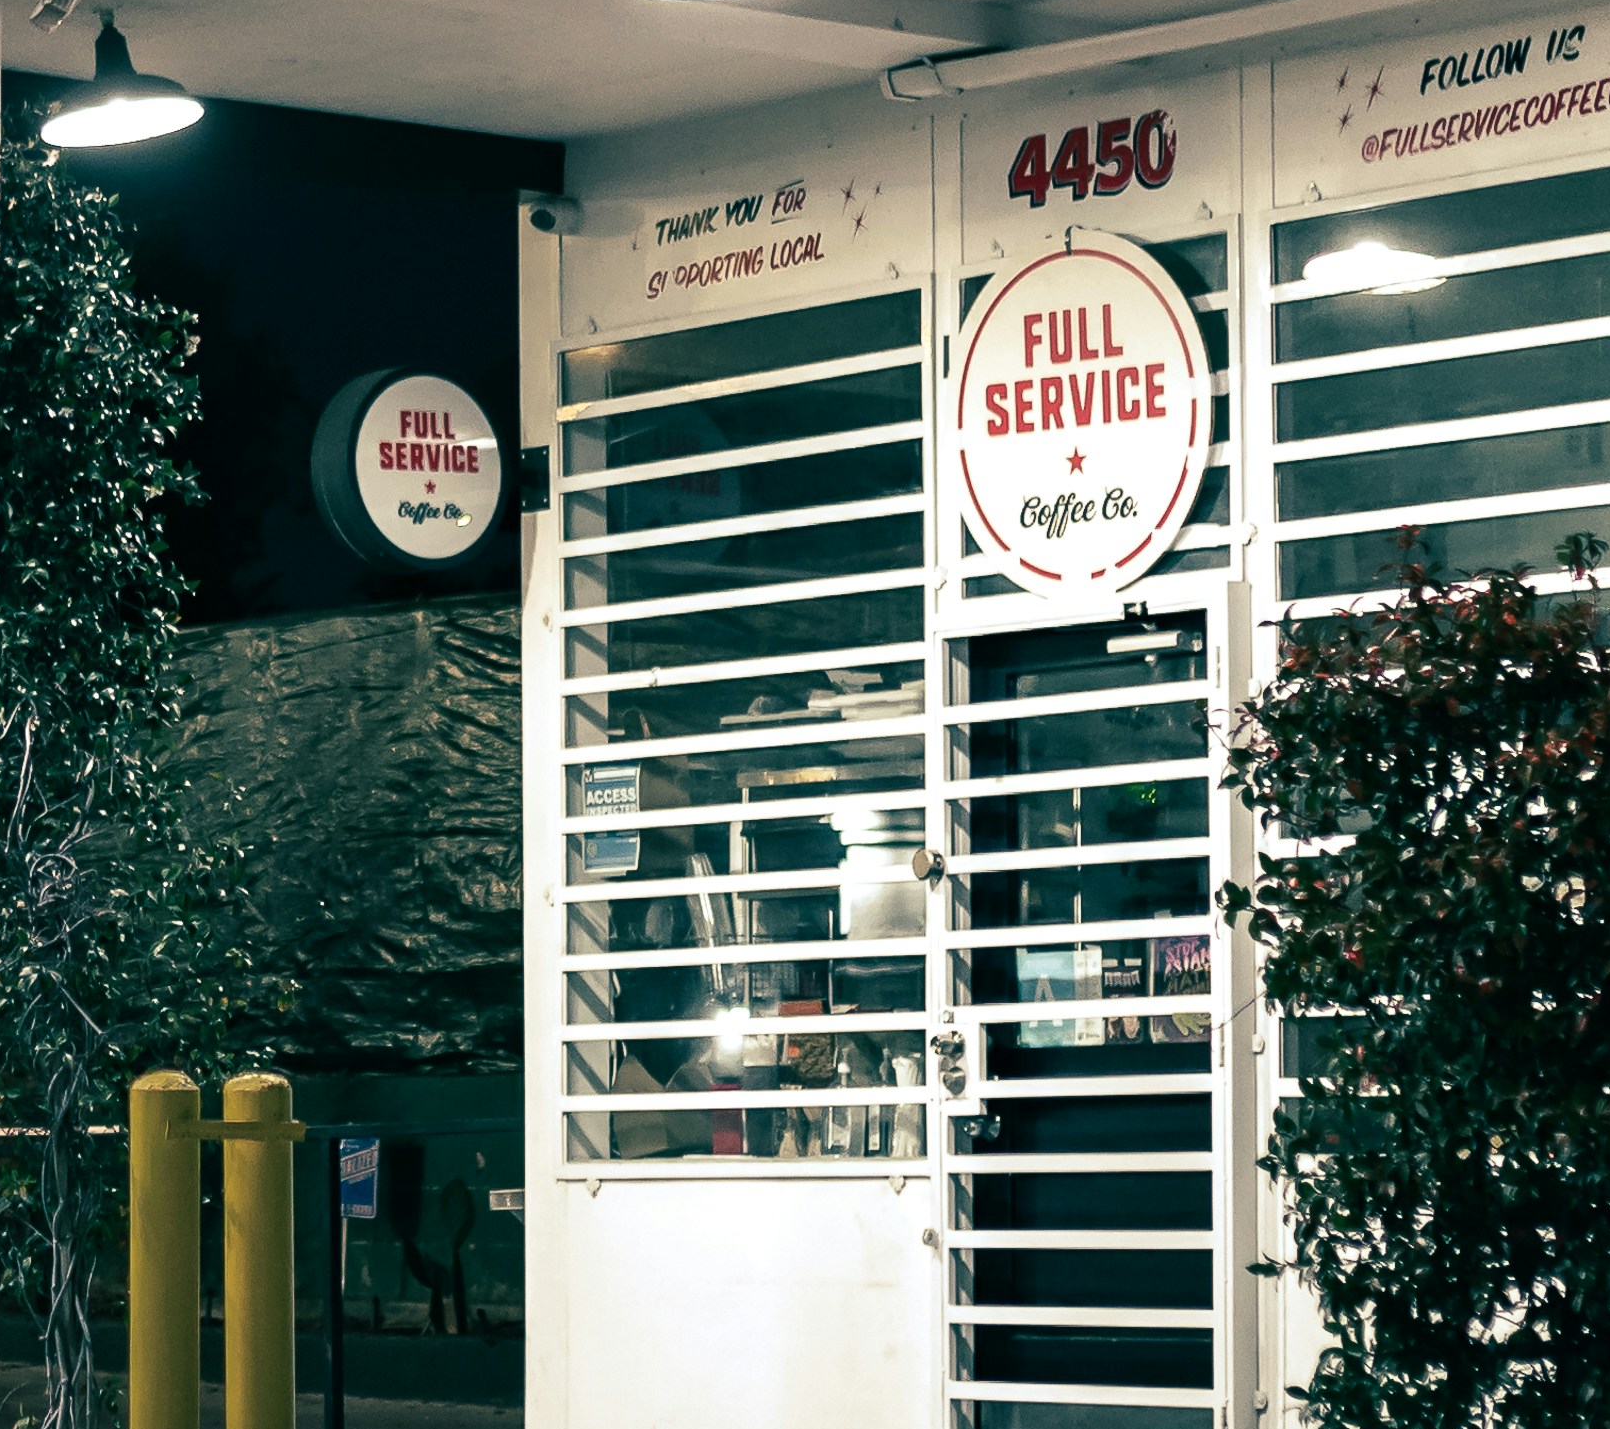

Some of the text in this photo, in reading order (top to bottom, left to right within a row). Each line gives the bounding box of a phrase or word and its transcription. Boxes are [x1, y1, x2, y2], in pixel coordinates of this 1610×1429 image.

[1420, 24, 1586, 95] FOLLOW US
[1008, 108, 1178, 209] 4450
[655, 185, 807, 247] THANK YOU FOR
[770, 232, 825, 271] LOCAL
[1023, 303, 1124, 368] FULL
[985, 363, 1167, 437] SERVICE
[399, 410, 456, 440] FULL
[379, 442, 480, 473] SERVICE
[397, 500, 441, 525] Coffee
[1019, 494, 1097, 540] Coffee
[586, 788, 637, 805] ACCESS
